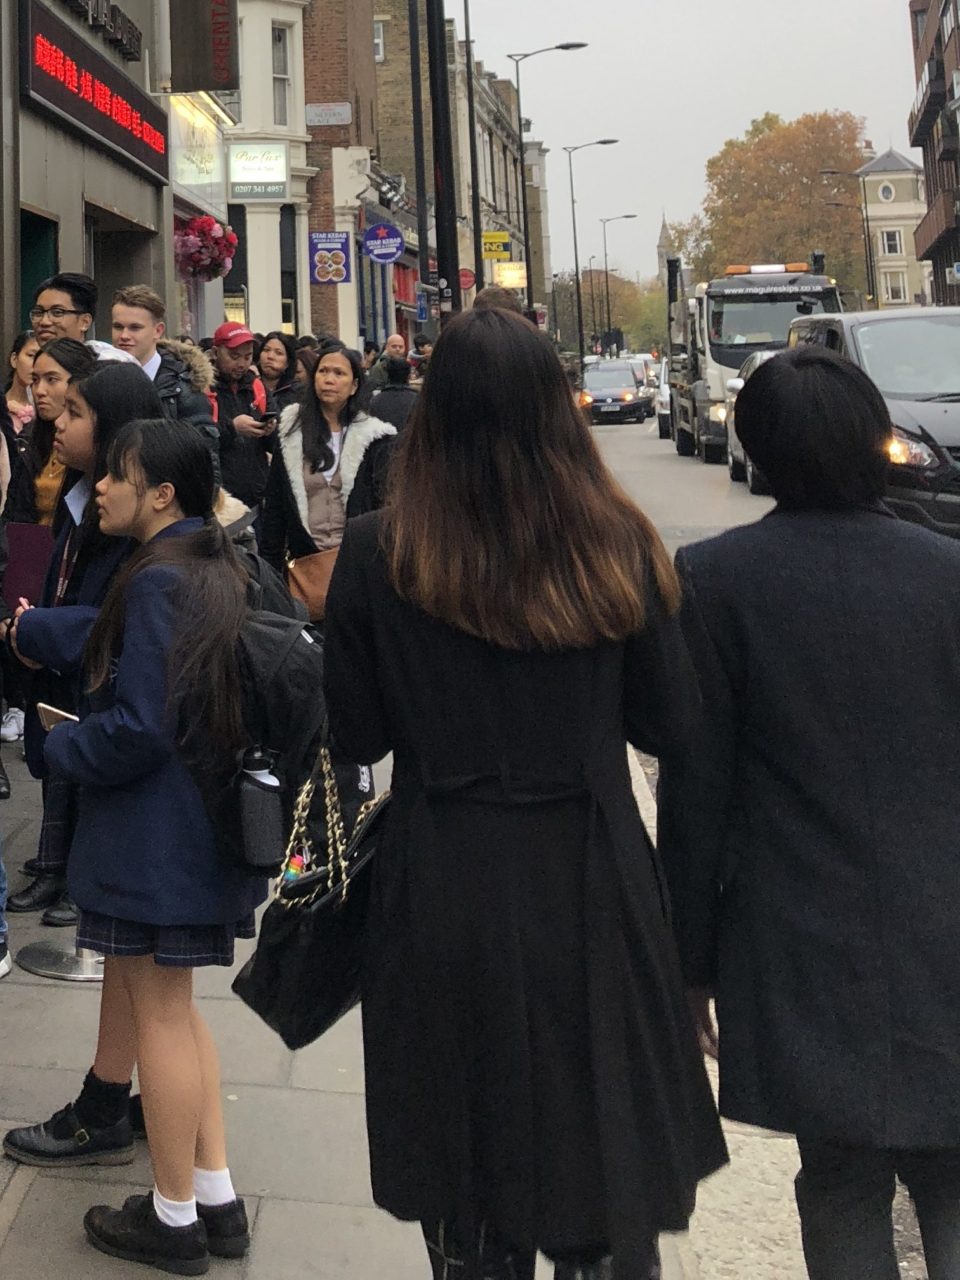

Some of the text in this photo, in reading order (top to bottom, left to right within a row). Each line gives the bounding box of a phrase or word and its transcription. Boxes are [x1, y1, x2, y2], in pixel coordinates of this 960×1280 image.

[235, 185, 284, 193] 0207 341 4957
[366, 239, 381, 247] STAR
